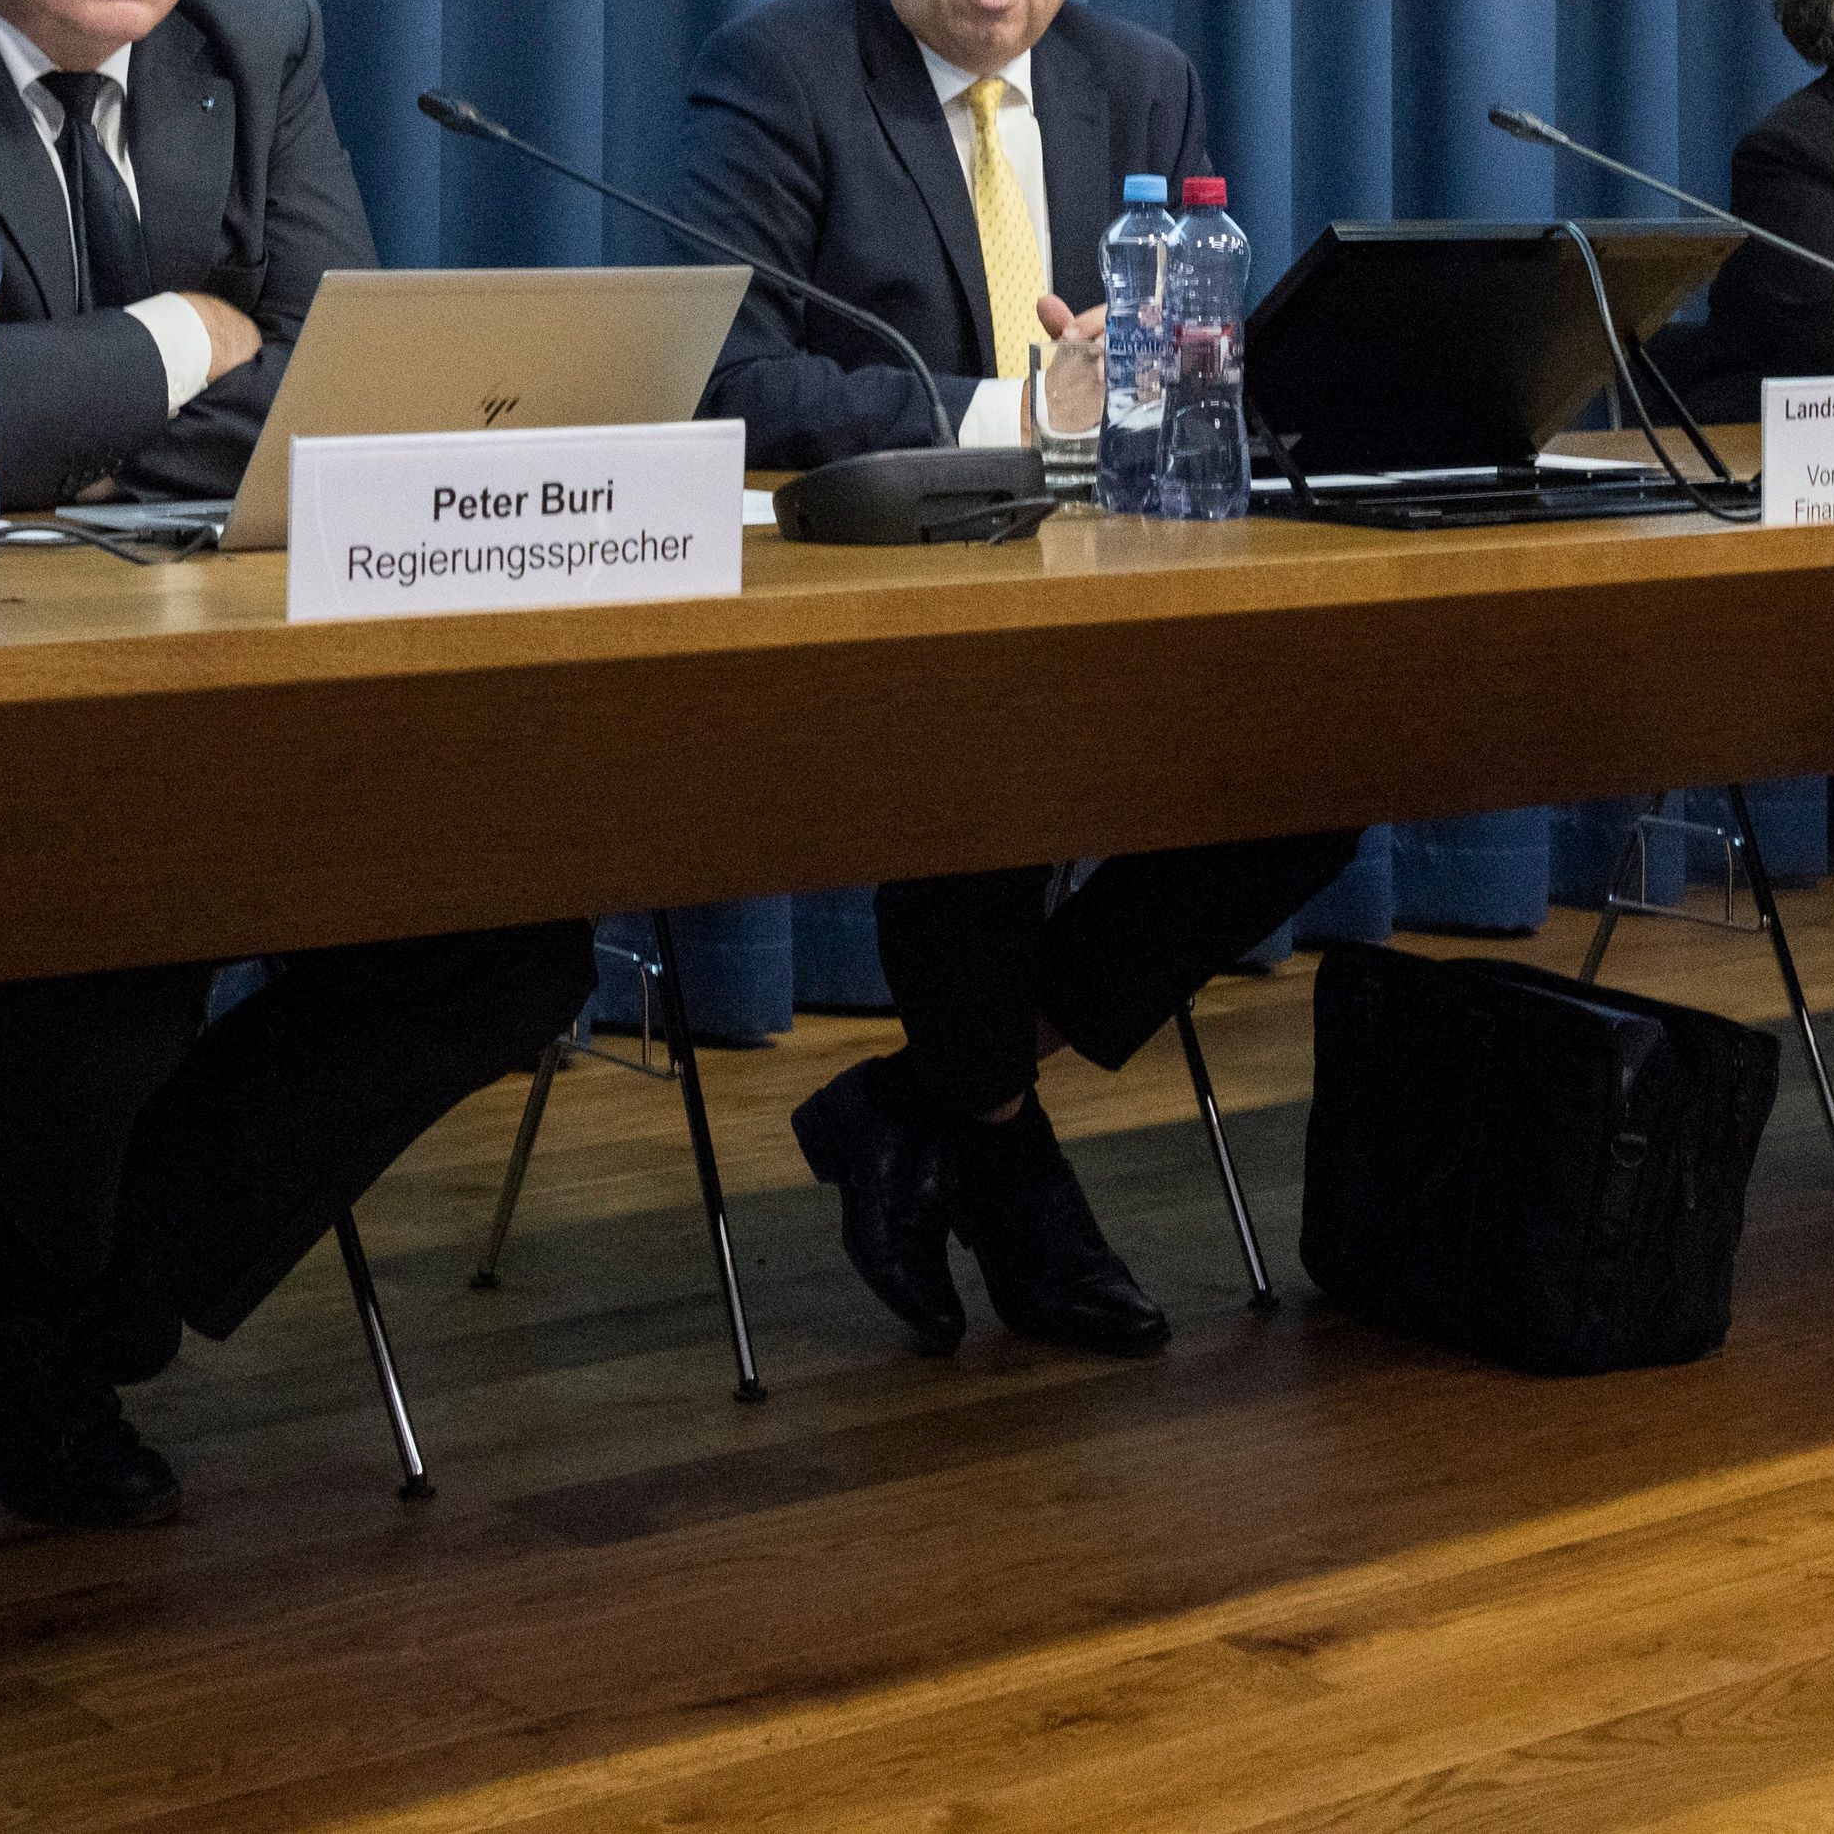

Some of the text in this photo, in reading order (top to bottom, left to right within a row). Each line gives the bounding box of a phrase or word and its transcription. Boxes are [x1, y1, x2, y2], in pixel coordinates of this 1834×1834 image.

[432, 480, 615, 522] Peter Buri
[347, 529, 694, 588] Regierungssprecher
